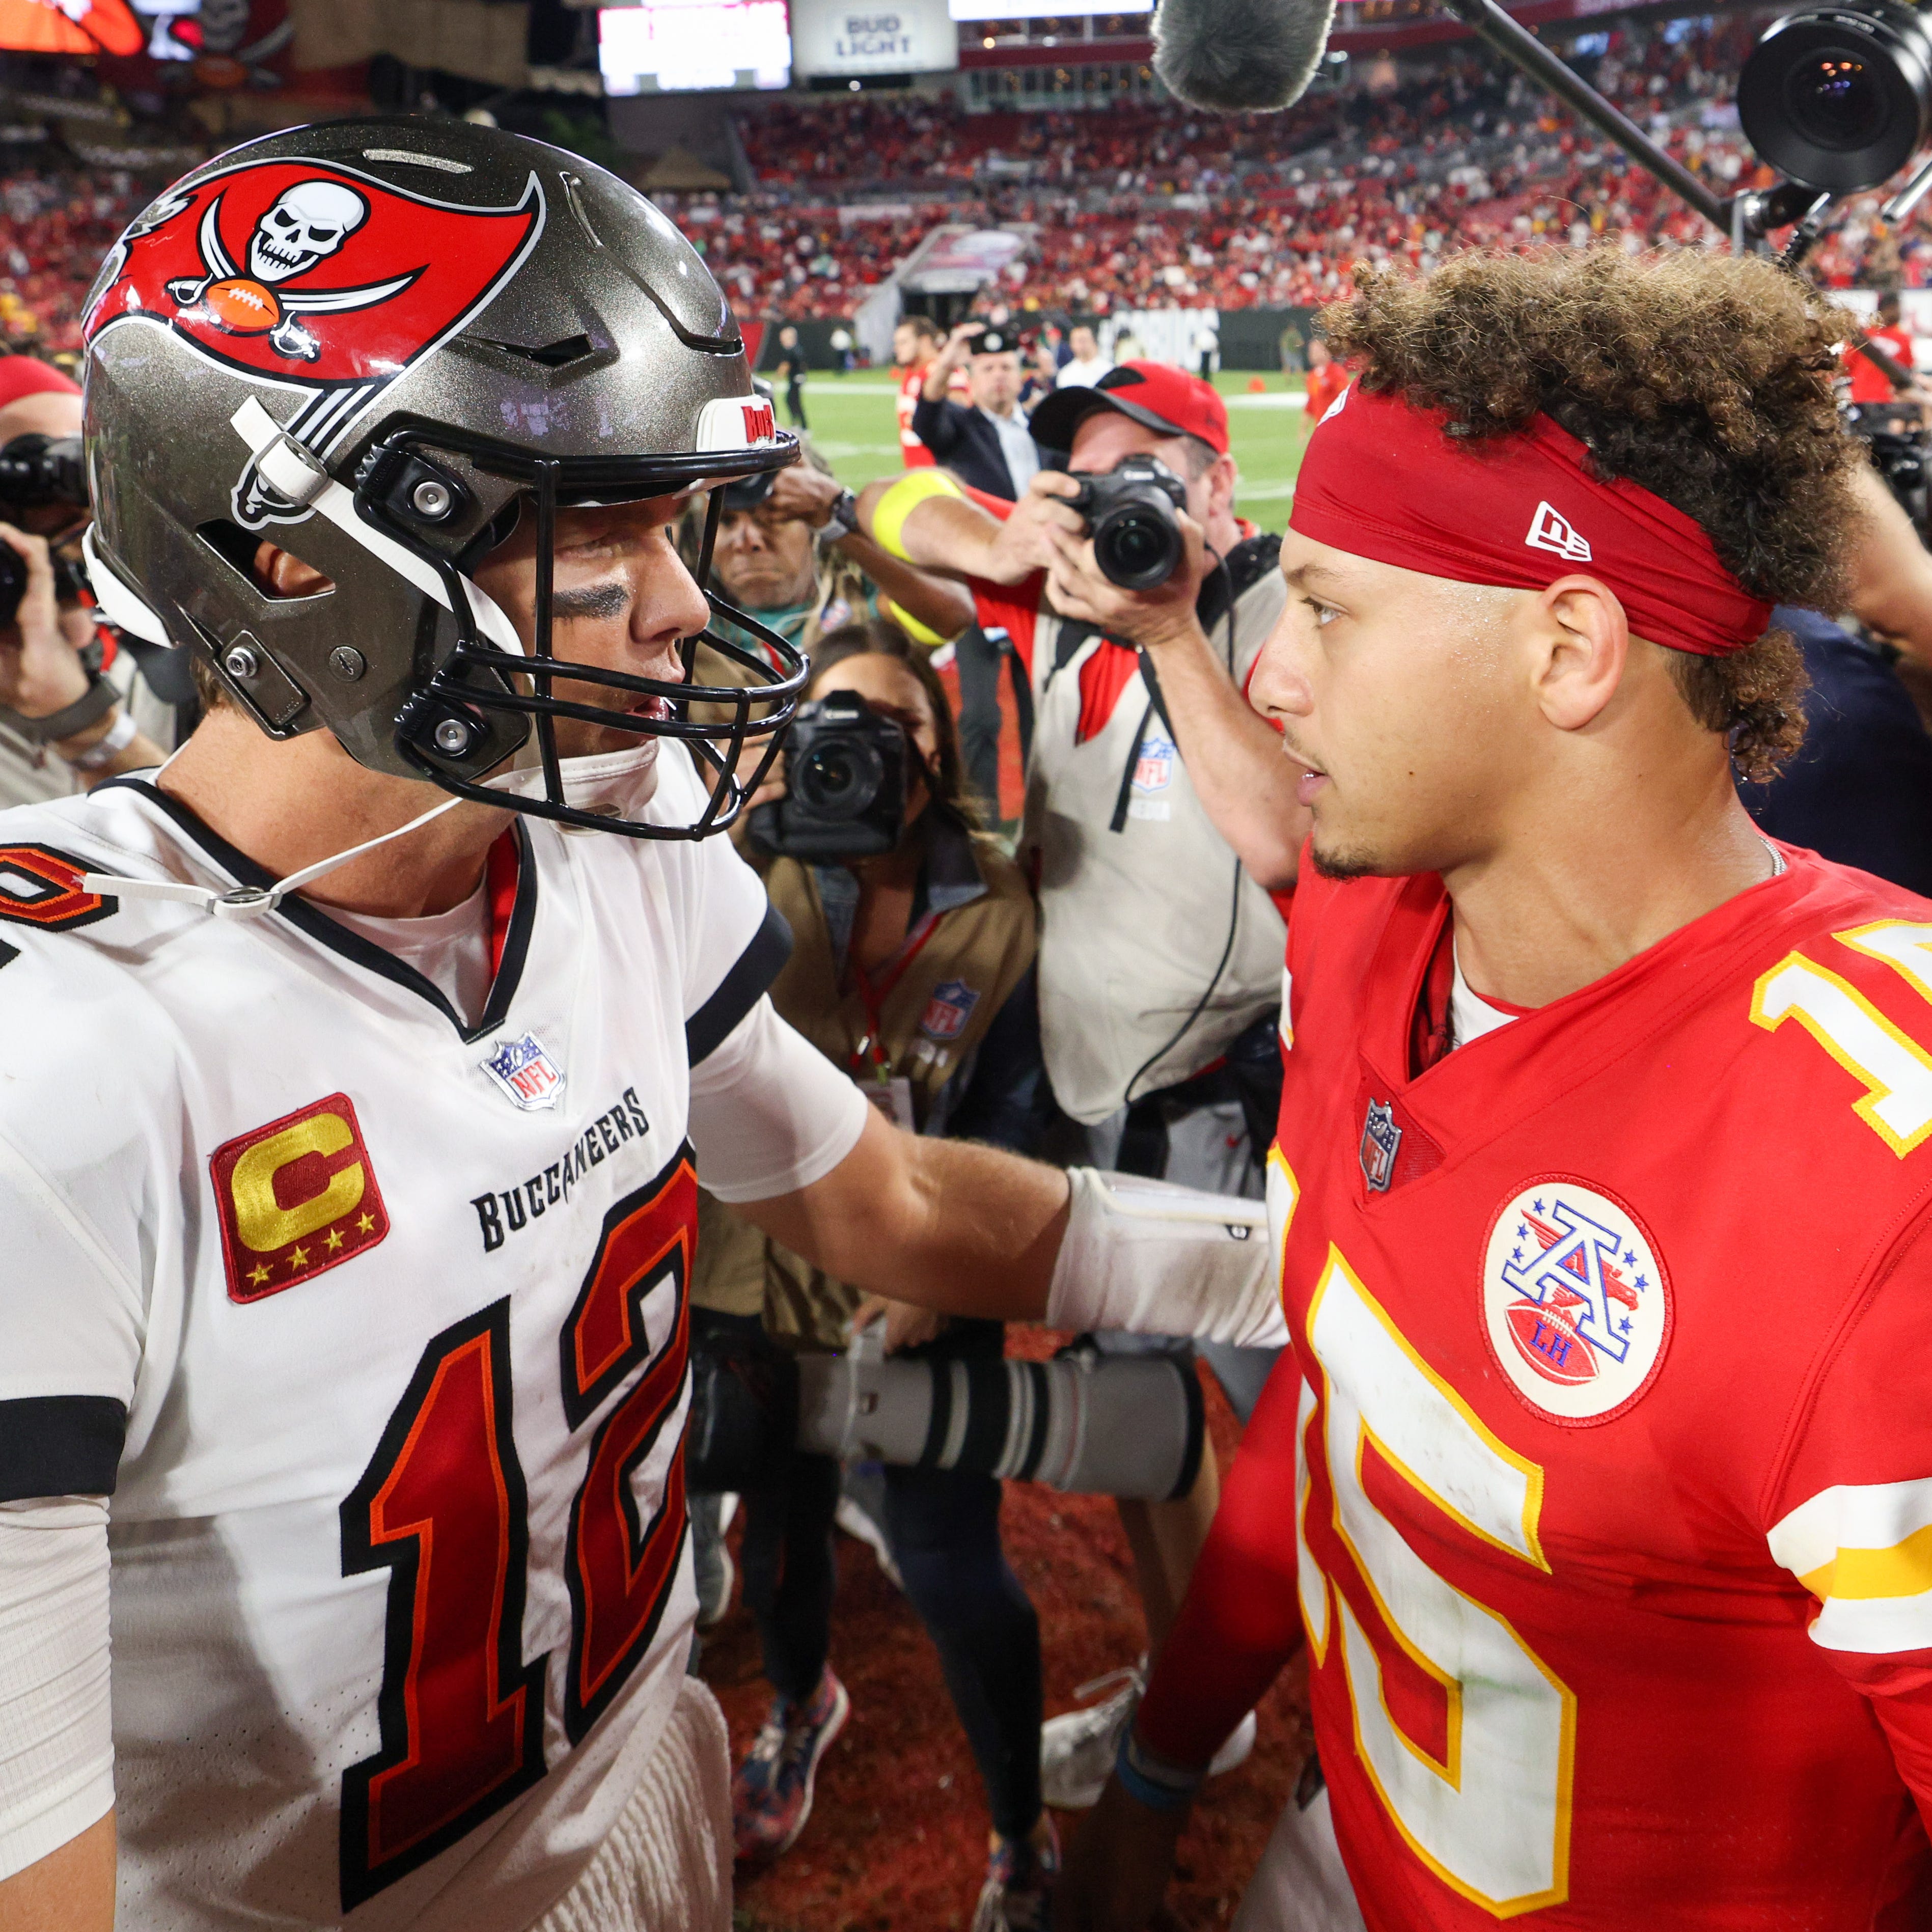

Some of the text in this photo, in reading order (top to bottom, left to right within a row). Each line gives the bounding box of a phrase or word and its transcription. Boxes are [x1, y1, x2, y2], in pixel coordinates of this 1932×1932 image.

[835, 36, 910, 56] LIGHT
[847, 16, 901, 34] BUD
[511, 1060, 557, 1099] NFL
[231, 1113, 365, 1252] C
[470, 1087, 650, 1253] BUCCANEERS
[1529, 1320, 1573, 1368] LH
[340, 1136, 699, 1915] 12
